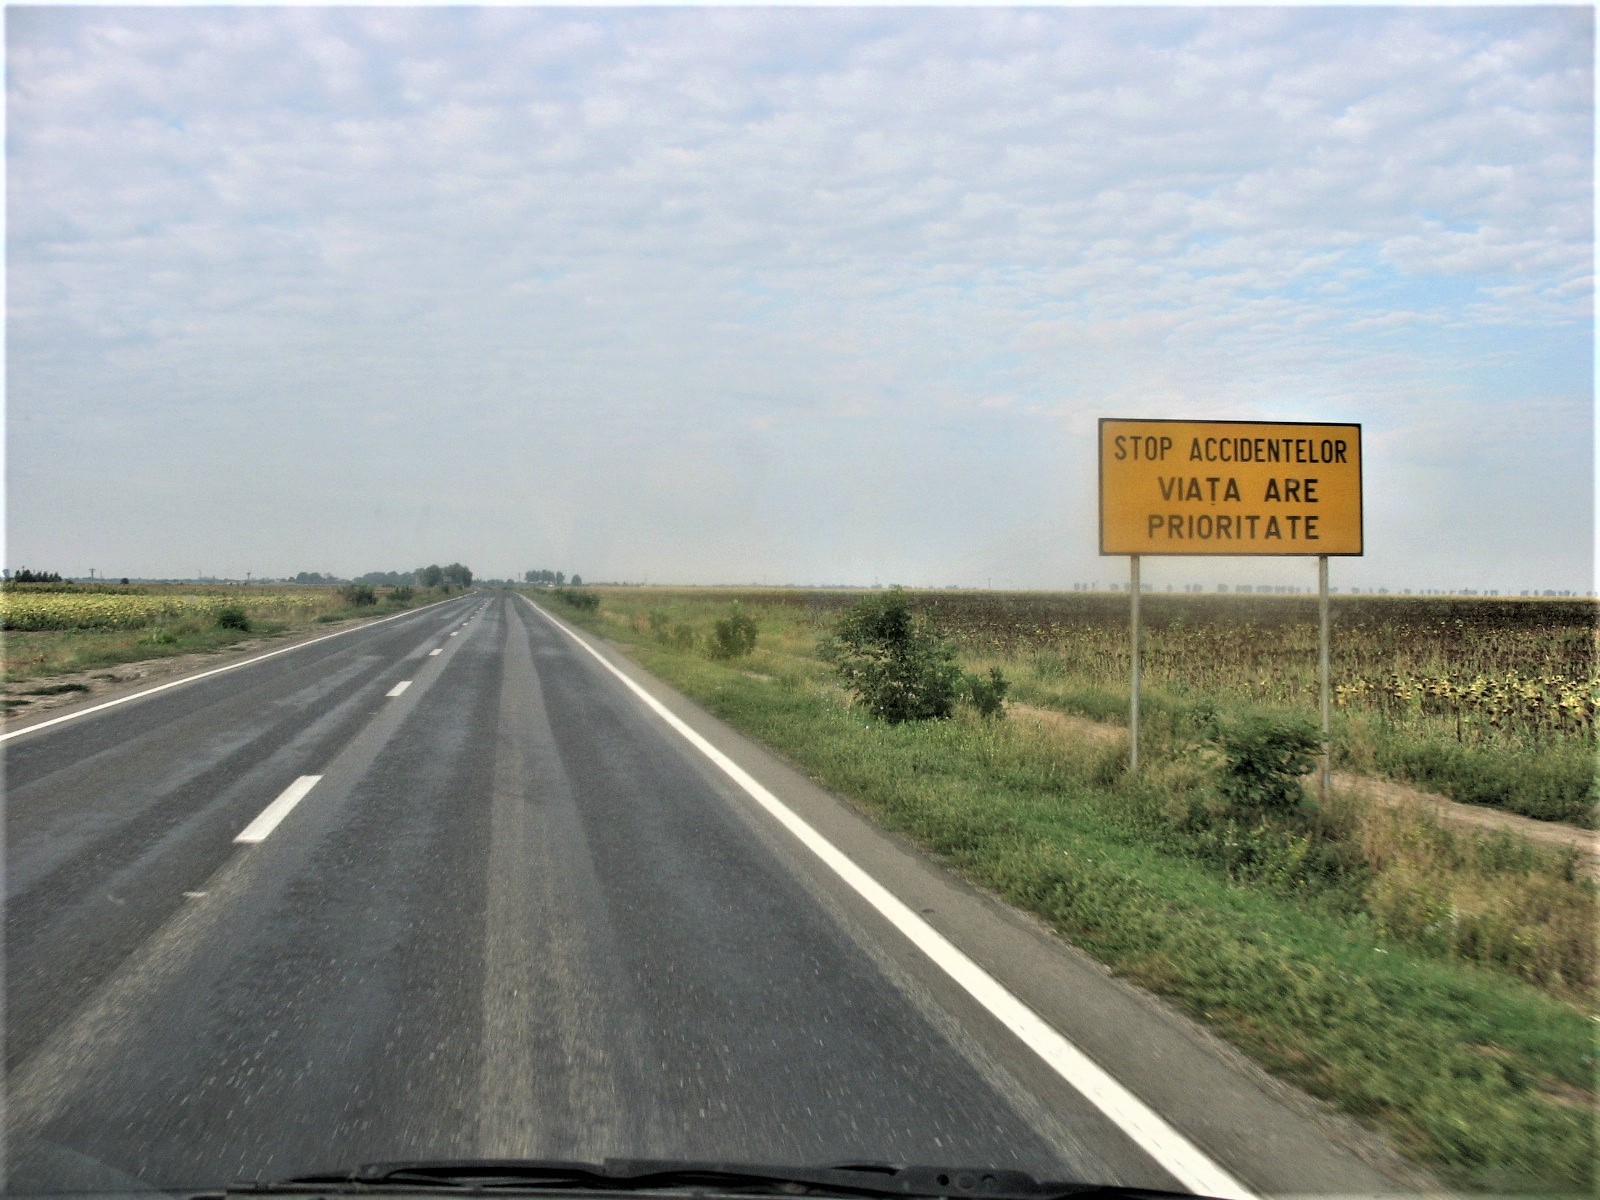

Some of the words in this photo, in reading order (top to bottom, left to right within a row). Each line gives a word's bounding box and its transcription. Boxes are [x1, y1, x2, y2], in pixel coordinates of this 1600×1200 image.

[1114, 436, 1172, 461] STOP
[1190, 437, 1348, 464] ACCIDENTELOR
[1265, 478, 1319, 503] ARE
[1148, 514, 1320, 540] PRIORITATE
